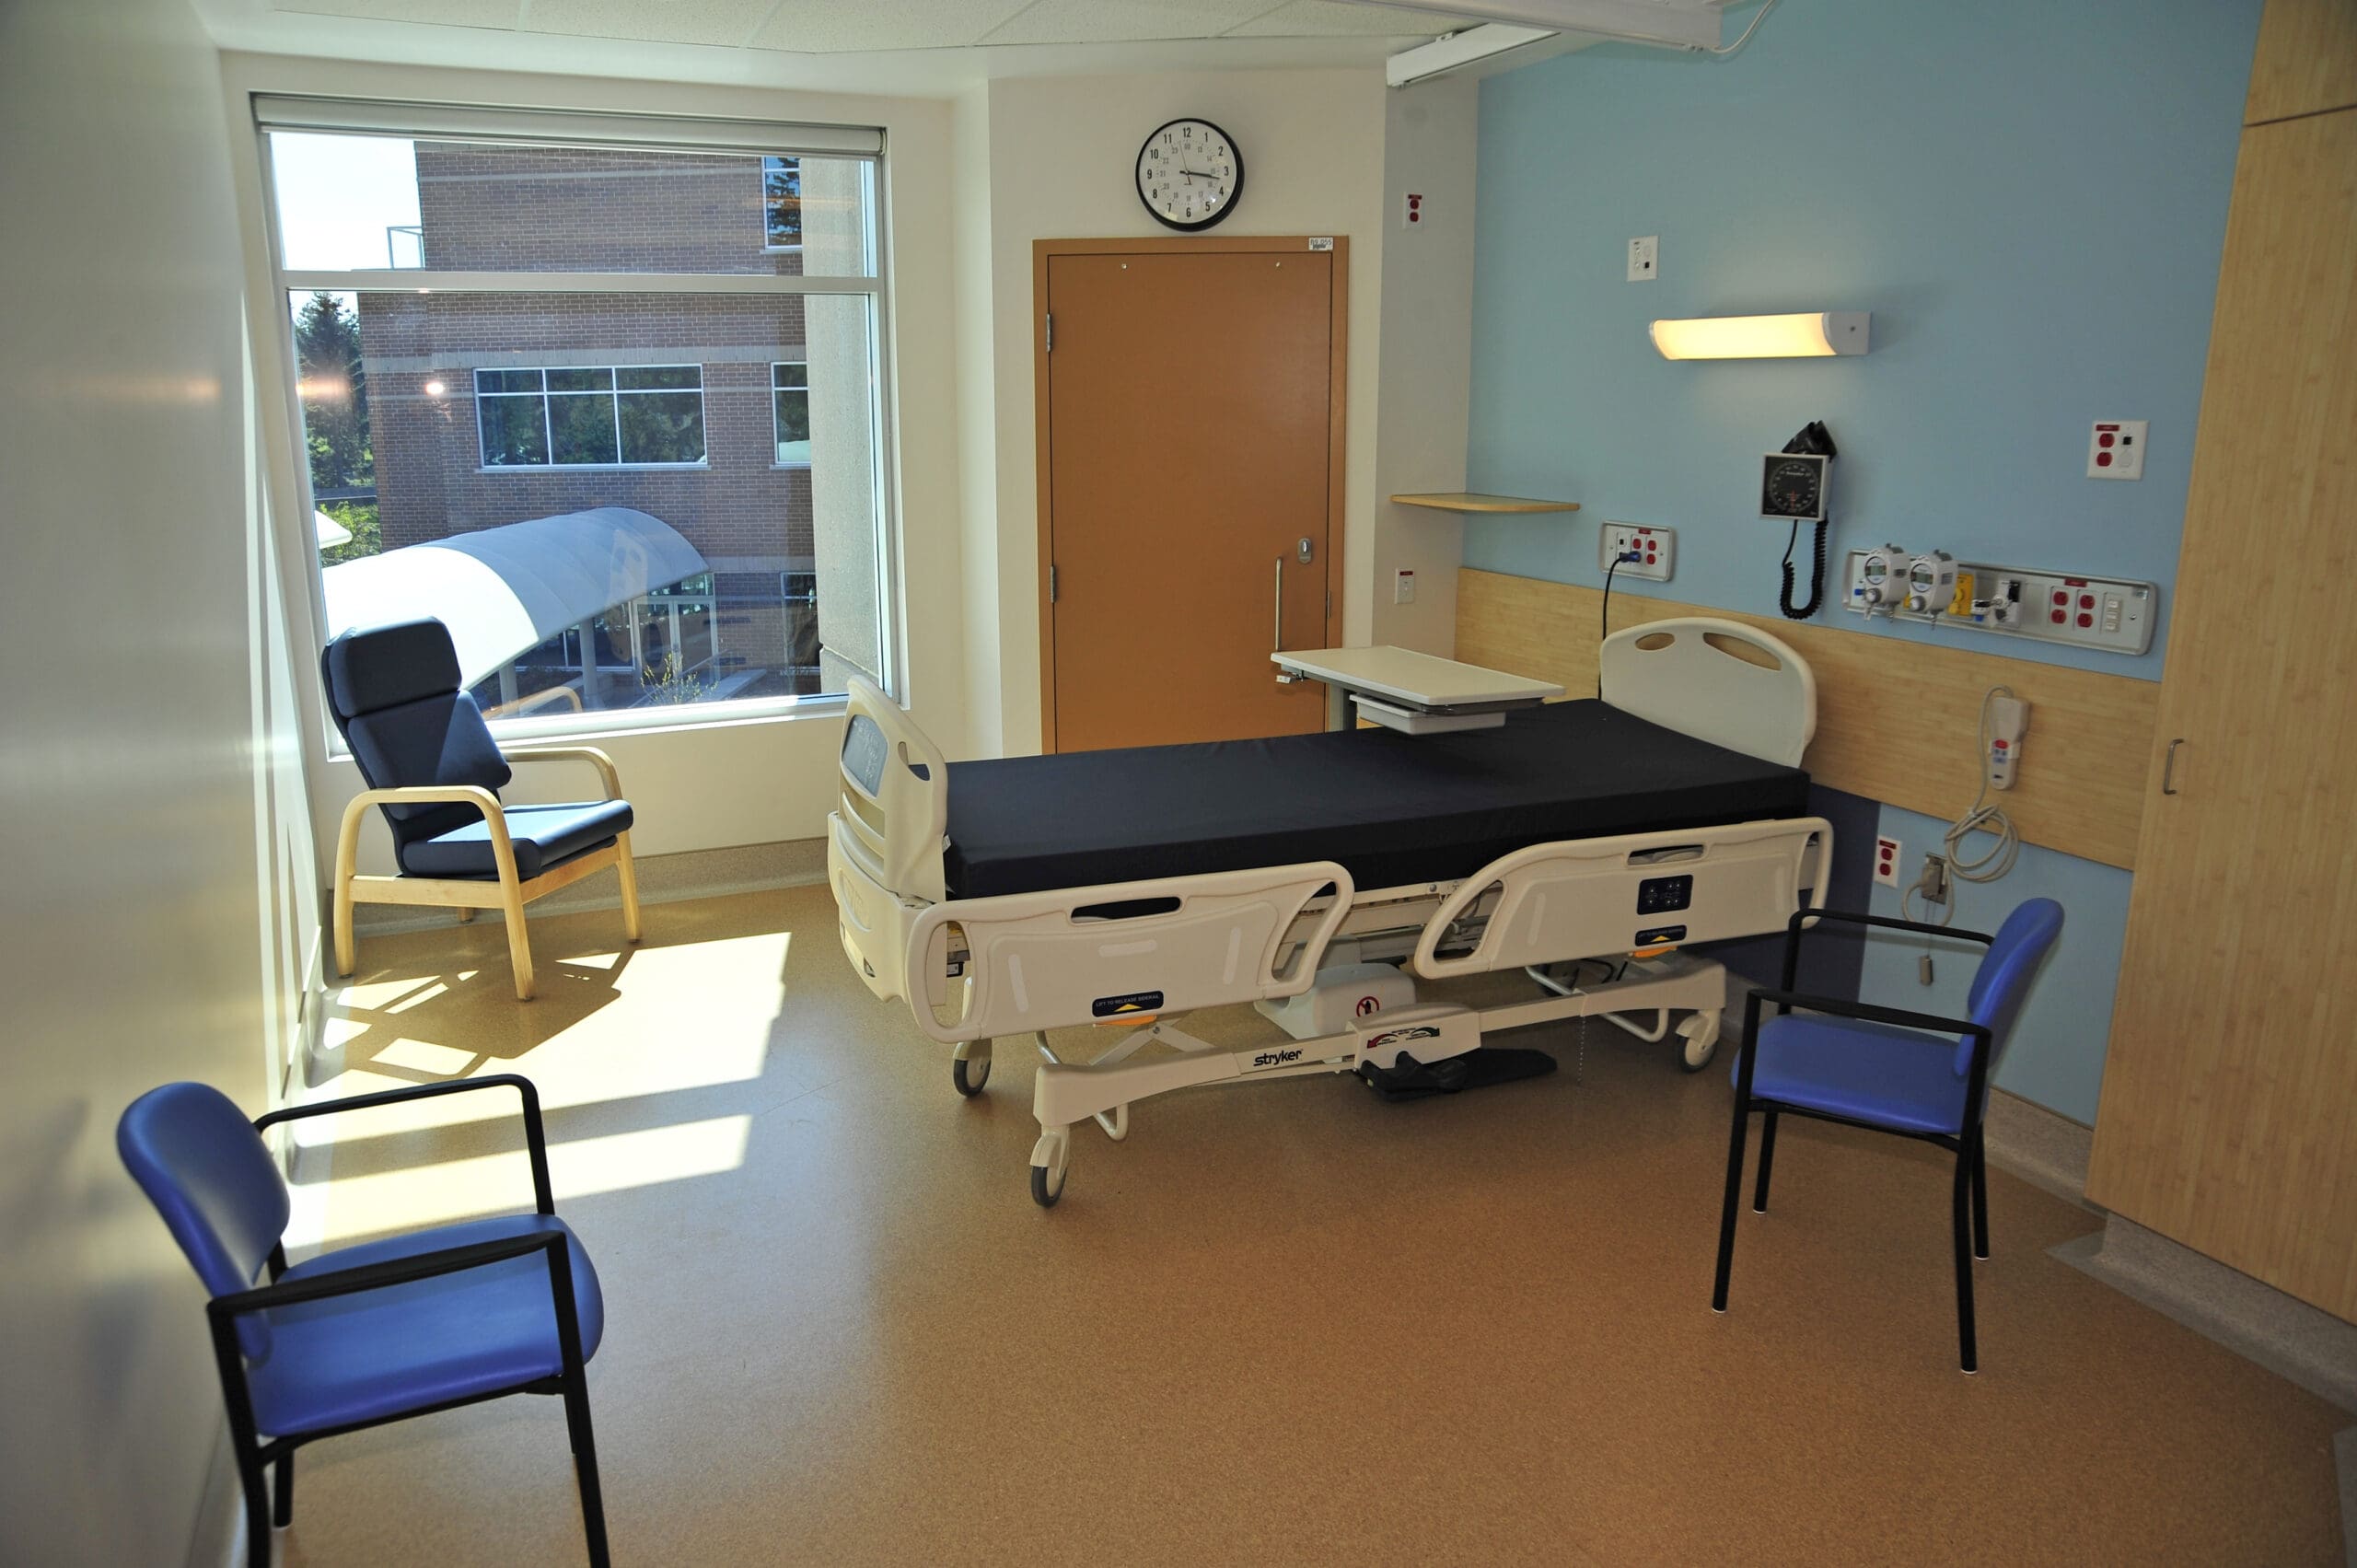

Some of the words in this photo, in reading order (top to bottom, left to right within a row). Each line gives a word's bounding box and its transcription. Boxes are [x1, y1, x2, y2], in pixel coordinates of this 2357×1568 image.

[1183, 127, 1191, 138] 12
[1164, 134, 1172, 144] 11
[1204, 133, 1208, 143] 1
[1150, 148, 1159, 159] 10
[1218, 145, 1224, 157] 2
[1147, 168, 1153, 180] 9
[1224, 166, 1229, 176] 3
[1153, 189, 1157, 199] 8
[1219, 186, 1225, 196] 4
[1167, 203, 1172, 213] 7
[1186, 207, 1191, 217] 6
[1205, 202, 1211, 212] 5
[1115, 996, 1137, 1005] RELEASE
[1253, 1050, 1302, 1067] stryker
